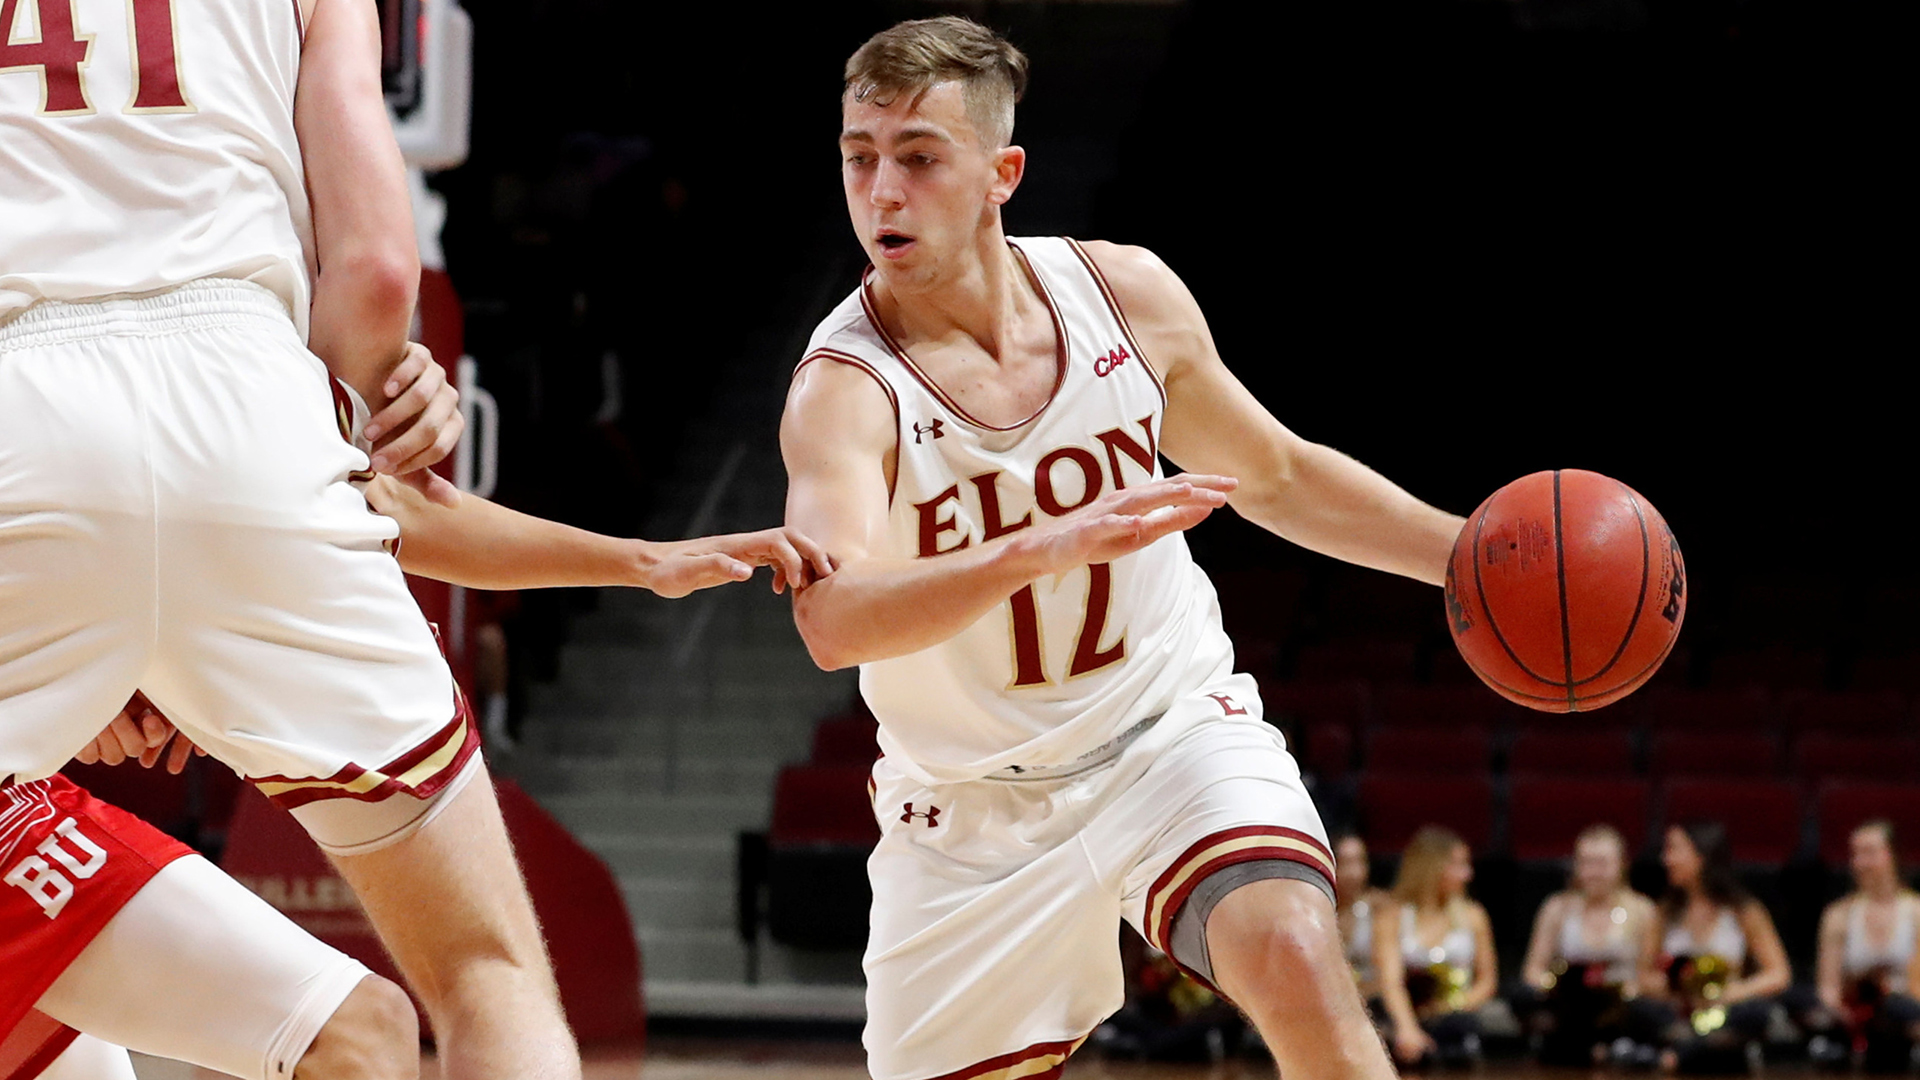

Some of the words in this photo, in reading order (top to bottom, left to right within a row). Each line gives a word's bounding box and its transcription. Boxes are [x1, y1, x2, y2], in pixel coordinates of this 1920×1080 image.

[0, 0, 198, 116] 41
[1093, 343, 1131, 378] CAA
[911, 411, 1156, 560] ELON
[1004, 562, 1128, 690] 12
[3, 816, 108, 920] BU
